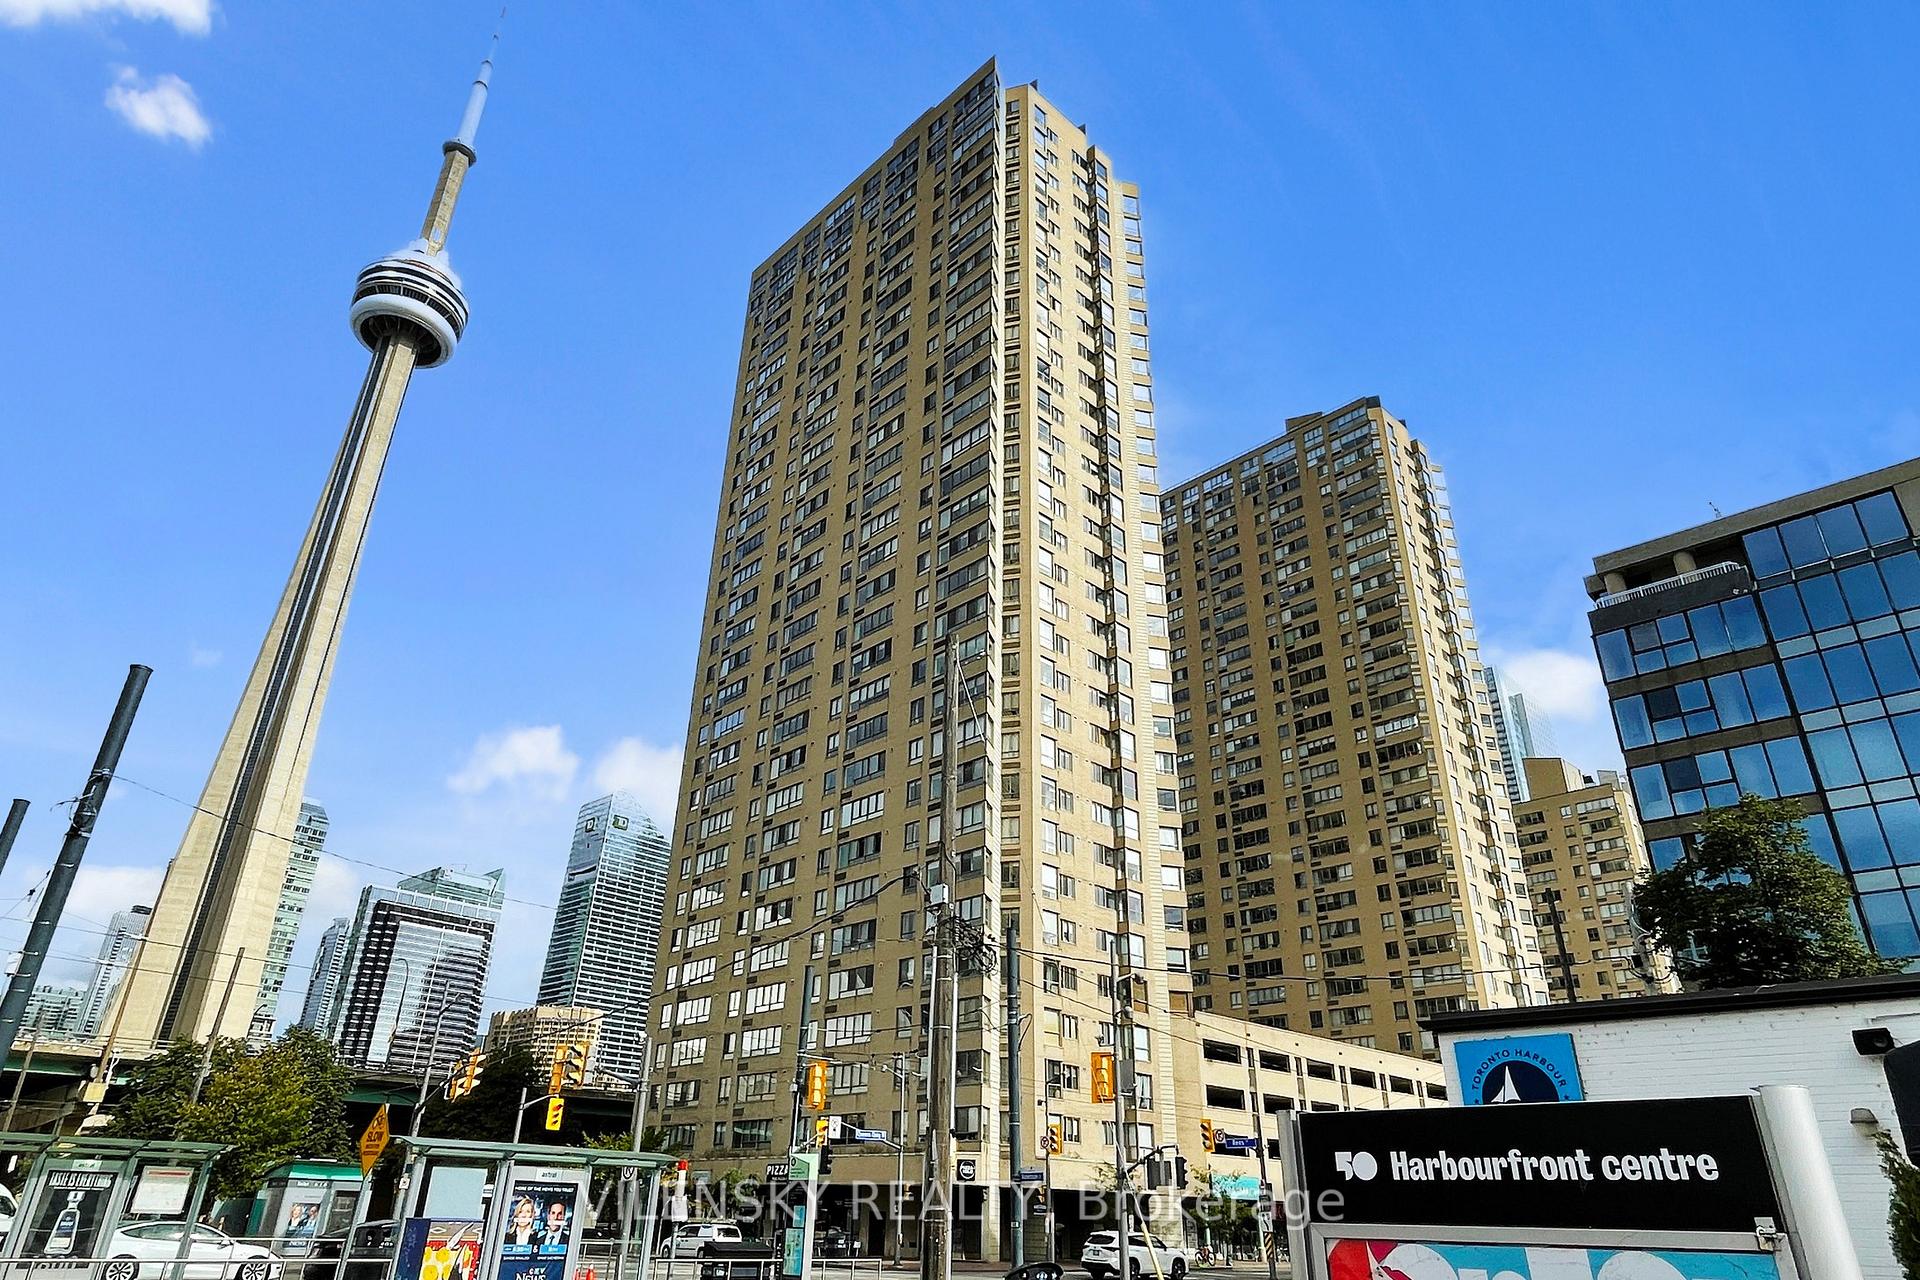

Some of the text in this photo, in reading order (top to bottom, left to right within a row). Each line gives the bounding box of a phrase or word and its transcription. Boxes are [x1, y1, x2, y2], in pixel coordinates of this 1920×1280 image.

[1472, 1049, 1567, 1091] TORONTO HARBOUR
[366, 1131, 385, 1142] SLOW
[1389, 1149, 1594, 1182] Harbourfront
[1601, 1148, 1719, 1181] centre
